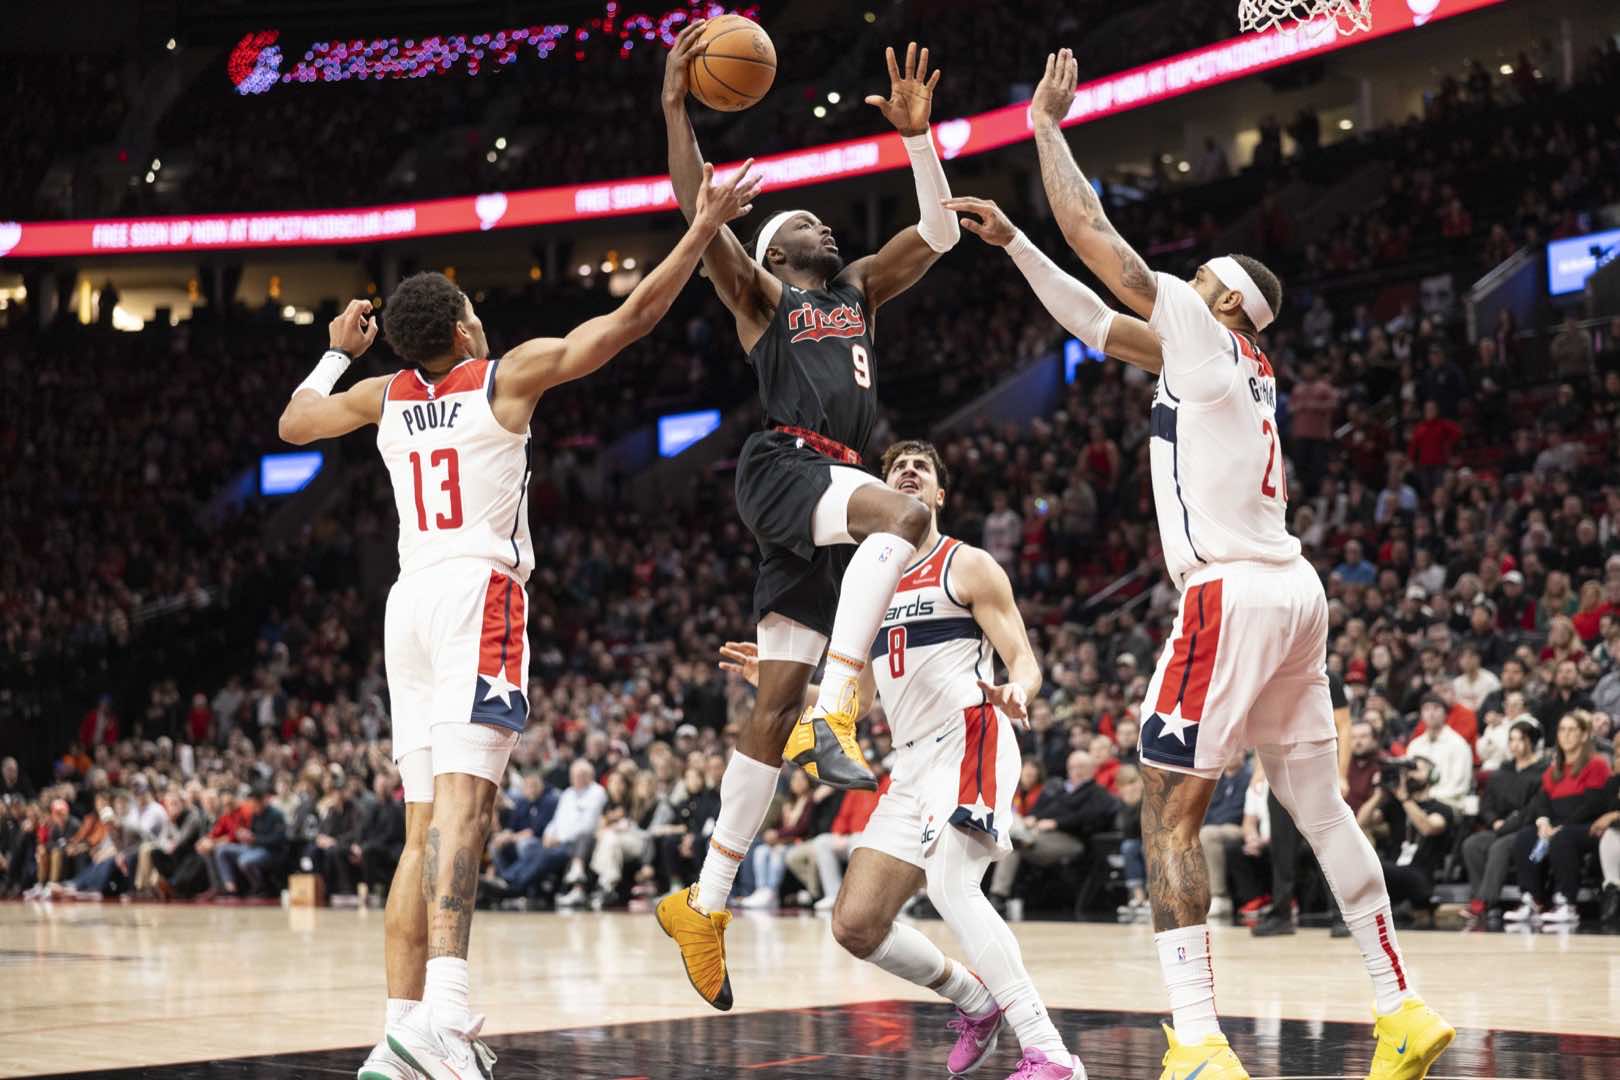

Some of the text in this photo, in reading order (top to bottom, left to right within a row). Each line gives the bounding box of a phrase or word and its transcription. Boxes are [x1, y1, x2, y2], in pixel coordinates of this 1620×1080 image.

[92, 223, 128, 248] FREE
[130, 222, 168, 247] SIGN
[851, 343, 871, 389] 9
[402, 401, 462, 436] POOLE
[409, 447, 464, 532] 13
[888, 625, 907, 679] 8
